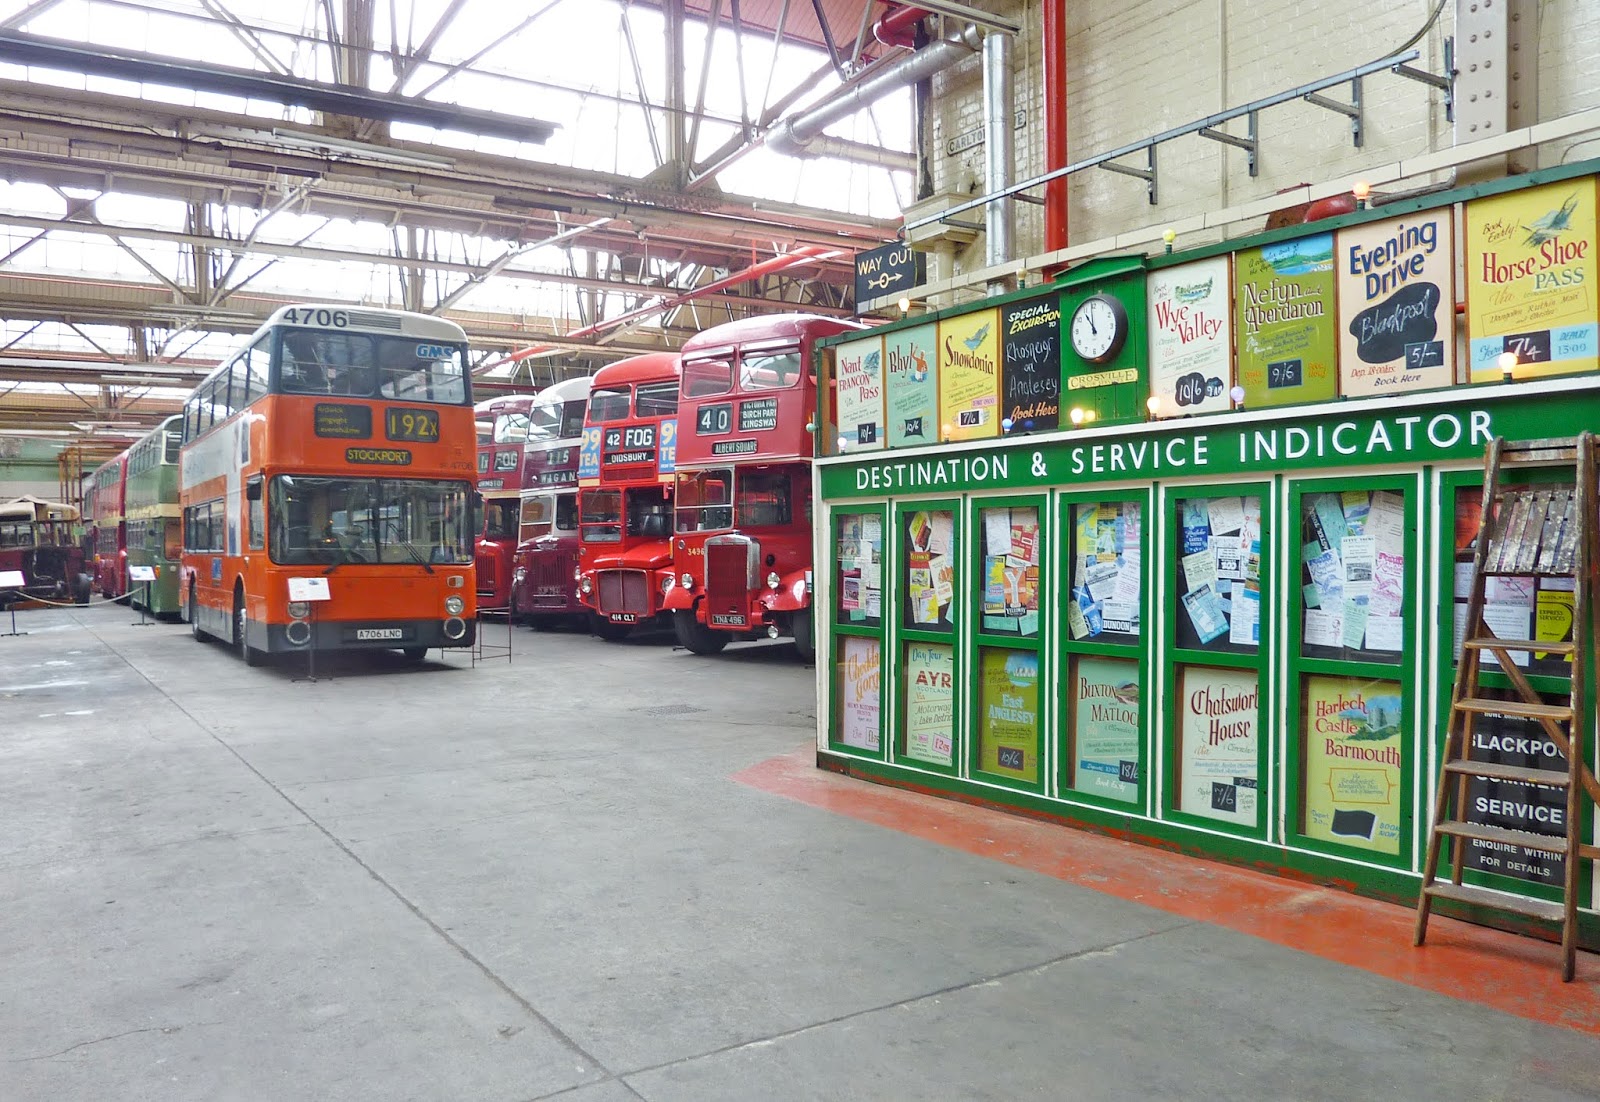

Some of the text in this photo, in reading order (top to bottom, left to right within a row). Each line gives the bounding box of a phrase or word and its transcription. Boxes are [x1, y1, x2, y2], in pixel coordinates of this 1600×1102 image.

[949, 129, 986, 154] CARLTO
[1350, 222, 1437, 276] Evening
[858, 247, 912, 276] WAY OUT
[1482, 236, 1588, 284] Horse Shoe
[1366, 253, 1425, 301] Drive
[1536, 267, 1584, 290] PASS
[1242, 278, 1304, 310] Nefyn
[283, 307, 348, 329] 4706
[1008, 303, 1051, 322] SPECIAL
[1009, 311, 1060, 334] EXCURSION
[1155, 299, 1189, 332] Wye
[1245, 300, 1324, 334] Aberdaron
[1362, 289, 1430, 345] Blackpool
[1178, 311, 1223, 345] Valley
[416, 342, 453, 361] GMS
[888, 342, 914, 379] Rhyl
[945, 335, 994, 375] Snowdonia
[841, 355, 862, 376] Nant
[1272, 363, 1295, 386] 9/6
[839, 372, 871, 393] FRANCON
[1069, 370, 1135, 388] CROSVILLE
[1374, 373, 1422, 387] Book Here
[858, 385, 880, 403] Pass
[1179, 379, 1202, 404] 10/6
[742, 410, 762, 420] BIRCH
[963, 410, 976, 424] 7/6
[1011, 401, 1058, 425] Book Here
[580, 429, 601, 452] 99
[607, 428, 654, 447] 42 FOG
[660, 423, 677, 446] 9
[347, 449, 408, 463] STOCKPORT
[611, 452, 648, 463] DIDSBURY
[660, 446, 675, 461] TE
[714, 441, 758, 454] ALBERT SQUARE
[857, 410, 1494, 490] DESTINATION & SERVICE INDICATOR
[495, 452, 518, 468] FOG
[580, 452, 599, 467] TEA
[687, 547, 706, 557] 3496
[611, 613, 636, 623] 414 CLT
[715, 615, 743, 625] TNA 496
[1103, 620, 1129, 632] DUNOON
[359, 629, 403, 640] A706 LNC
[912, 647, 943, 663] Day Tour
[916, 670, 952, 689] AYR
[1080, 677, 1117, 700] BUXTON
[1002, 693, 1025, 709] East
[1315, 694, 1368, 718] Harlech
[919, 712, 953, 726] Lake Distric
[988, 704, 1036, 725] ANGLESEY
[1209, 718, 1251, 746] House
[1315, 717, 1358, 736] Castle
[1001, 750, 1019, 767] 10/6
[1326, 738, 1401, 768] Barmouth
[1476, 797, 1563, 824] SERVICE
[1473, 839, 1562, 862] ENQUIRE WITHIN
[1480, 856, 1550, 877] FOR DETAILS
